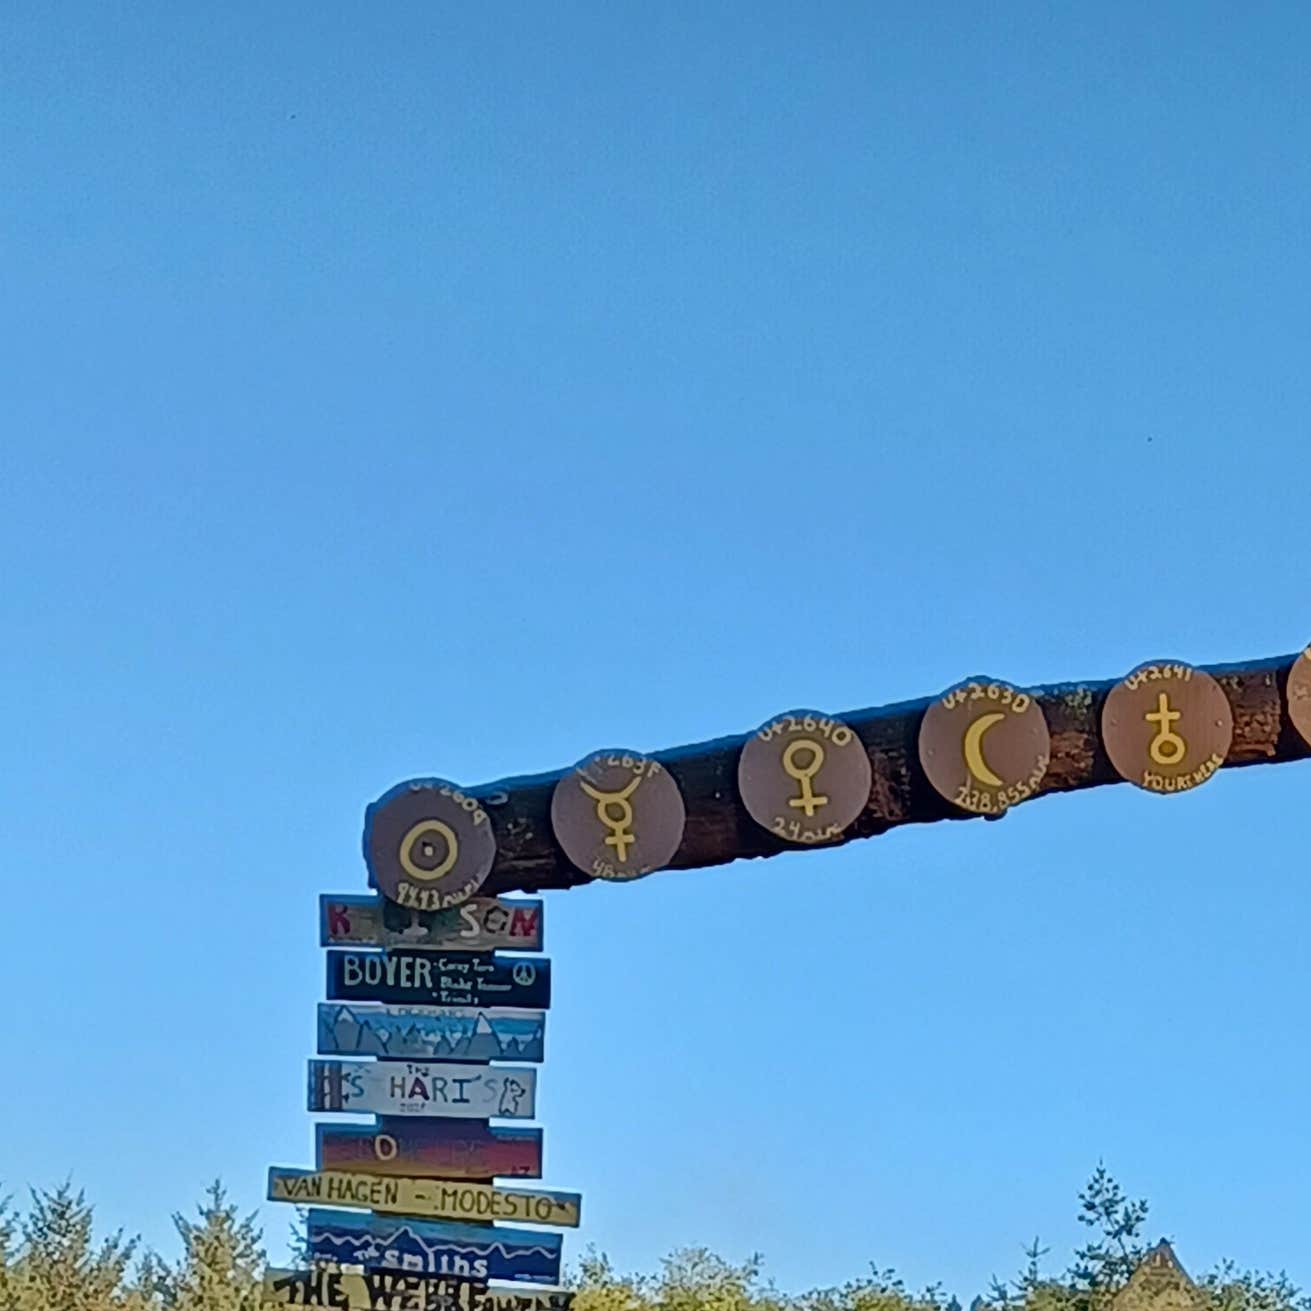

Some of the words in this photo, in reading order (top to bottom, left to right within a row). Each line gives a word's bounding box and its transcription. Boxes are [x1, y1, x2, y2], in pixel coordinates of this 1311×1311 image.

[758, 713, 852, 747] U+2640
[343, 954, 433, 989] BOYER
[282, 1177, 322, 1198] VAN
[327, 1177, 399, 1206] HAGEN
[440, 1188, 553, 1220] MODESTO
